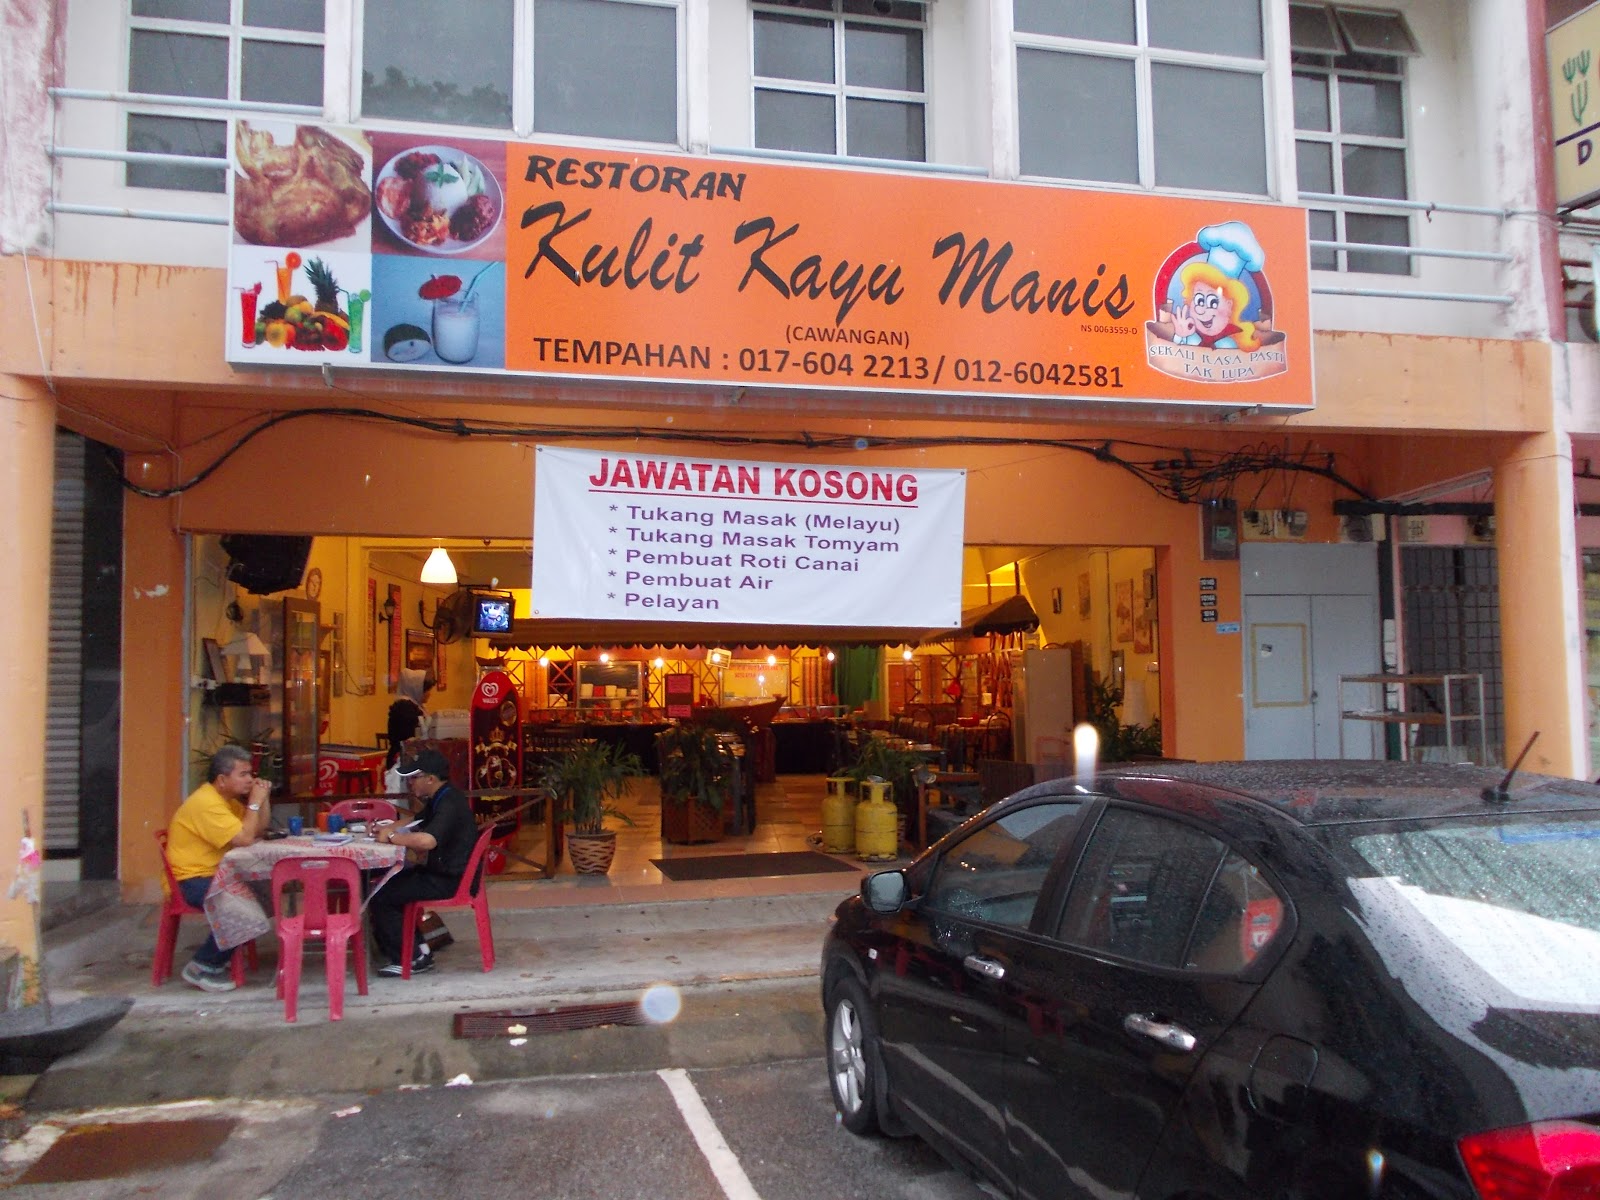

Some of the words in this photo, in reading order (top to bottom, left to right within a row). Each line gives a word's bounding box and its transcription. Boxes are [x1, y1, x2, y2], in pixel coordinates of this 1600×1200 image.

[524, 154, 747, 202] RESTORAN
[520, 200, 705, 294] Kulit
[733, 216, 905, 327] Kayu
[932, 231, 1135, 320] Manis
[786, 323, 910, 349] (CAWANGAN)
[1080, 324, 1092, 333] NS
[533, 337, 711, 370] TEMPAHAN
[739, 347, 854, 377] 017-604
[954, 358, 1124, 388] 012-6042581
[1150, 345, 1195, 360] SEKALI
[1202, 353, 1242, 366] RASA
[1250, 351, 1285, 363] PASTI
[1184, 363, 1213, 378] TAK
[1221, 367, 1255, 379] LUPA
[588, 458, 761, 495] JAWATAN
[773, 467, 919, 503] KOSONG
[626, 505, 714, 527] Tukang
[723, 510, 797, 527] Masak
[804, 514, 901, 535] (Melayu)
[625, 527, 713, 549] Tukang
[722, 531, 796, 548] Masak
[803, 535, 900, 554] Tomyam
[625, 549, 733, 568] Pembuat
[740, 553, 787, 569] Roti
[795, 556, 860, 572] Canai
[624, 571, 732, 589] Pembuat
[738, 575, 773, 590] Air
[624, 593, 719, 612] Pelayan
